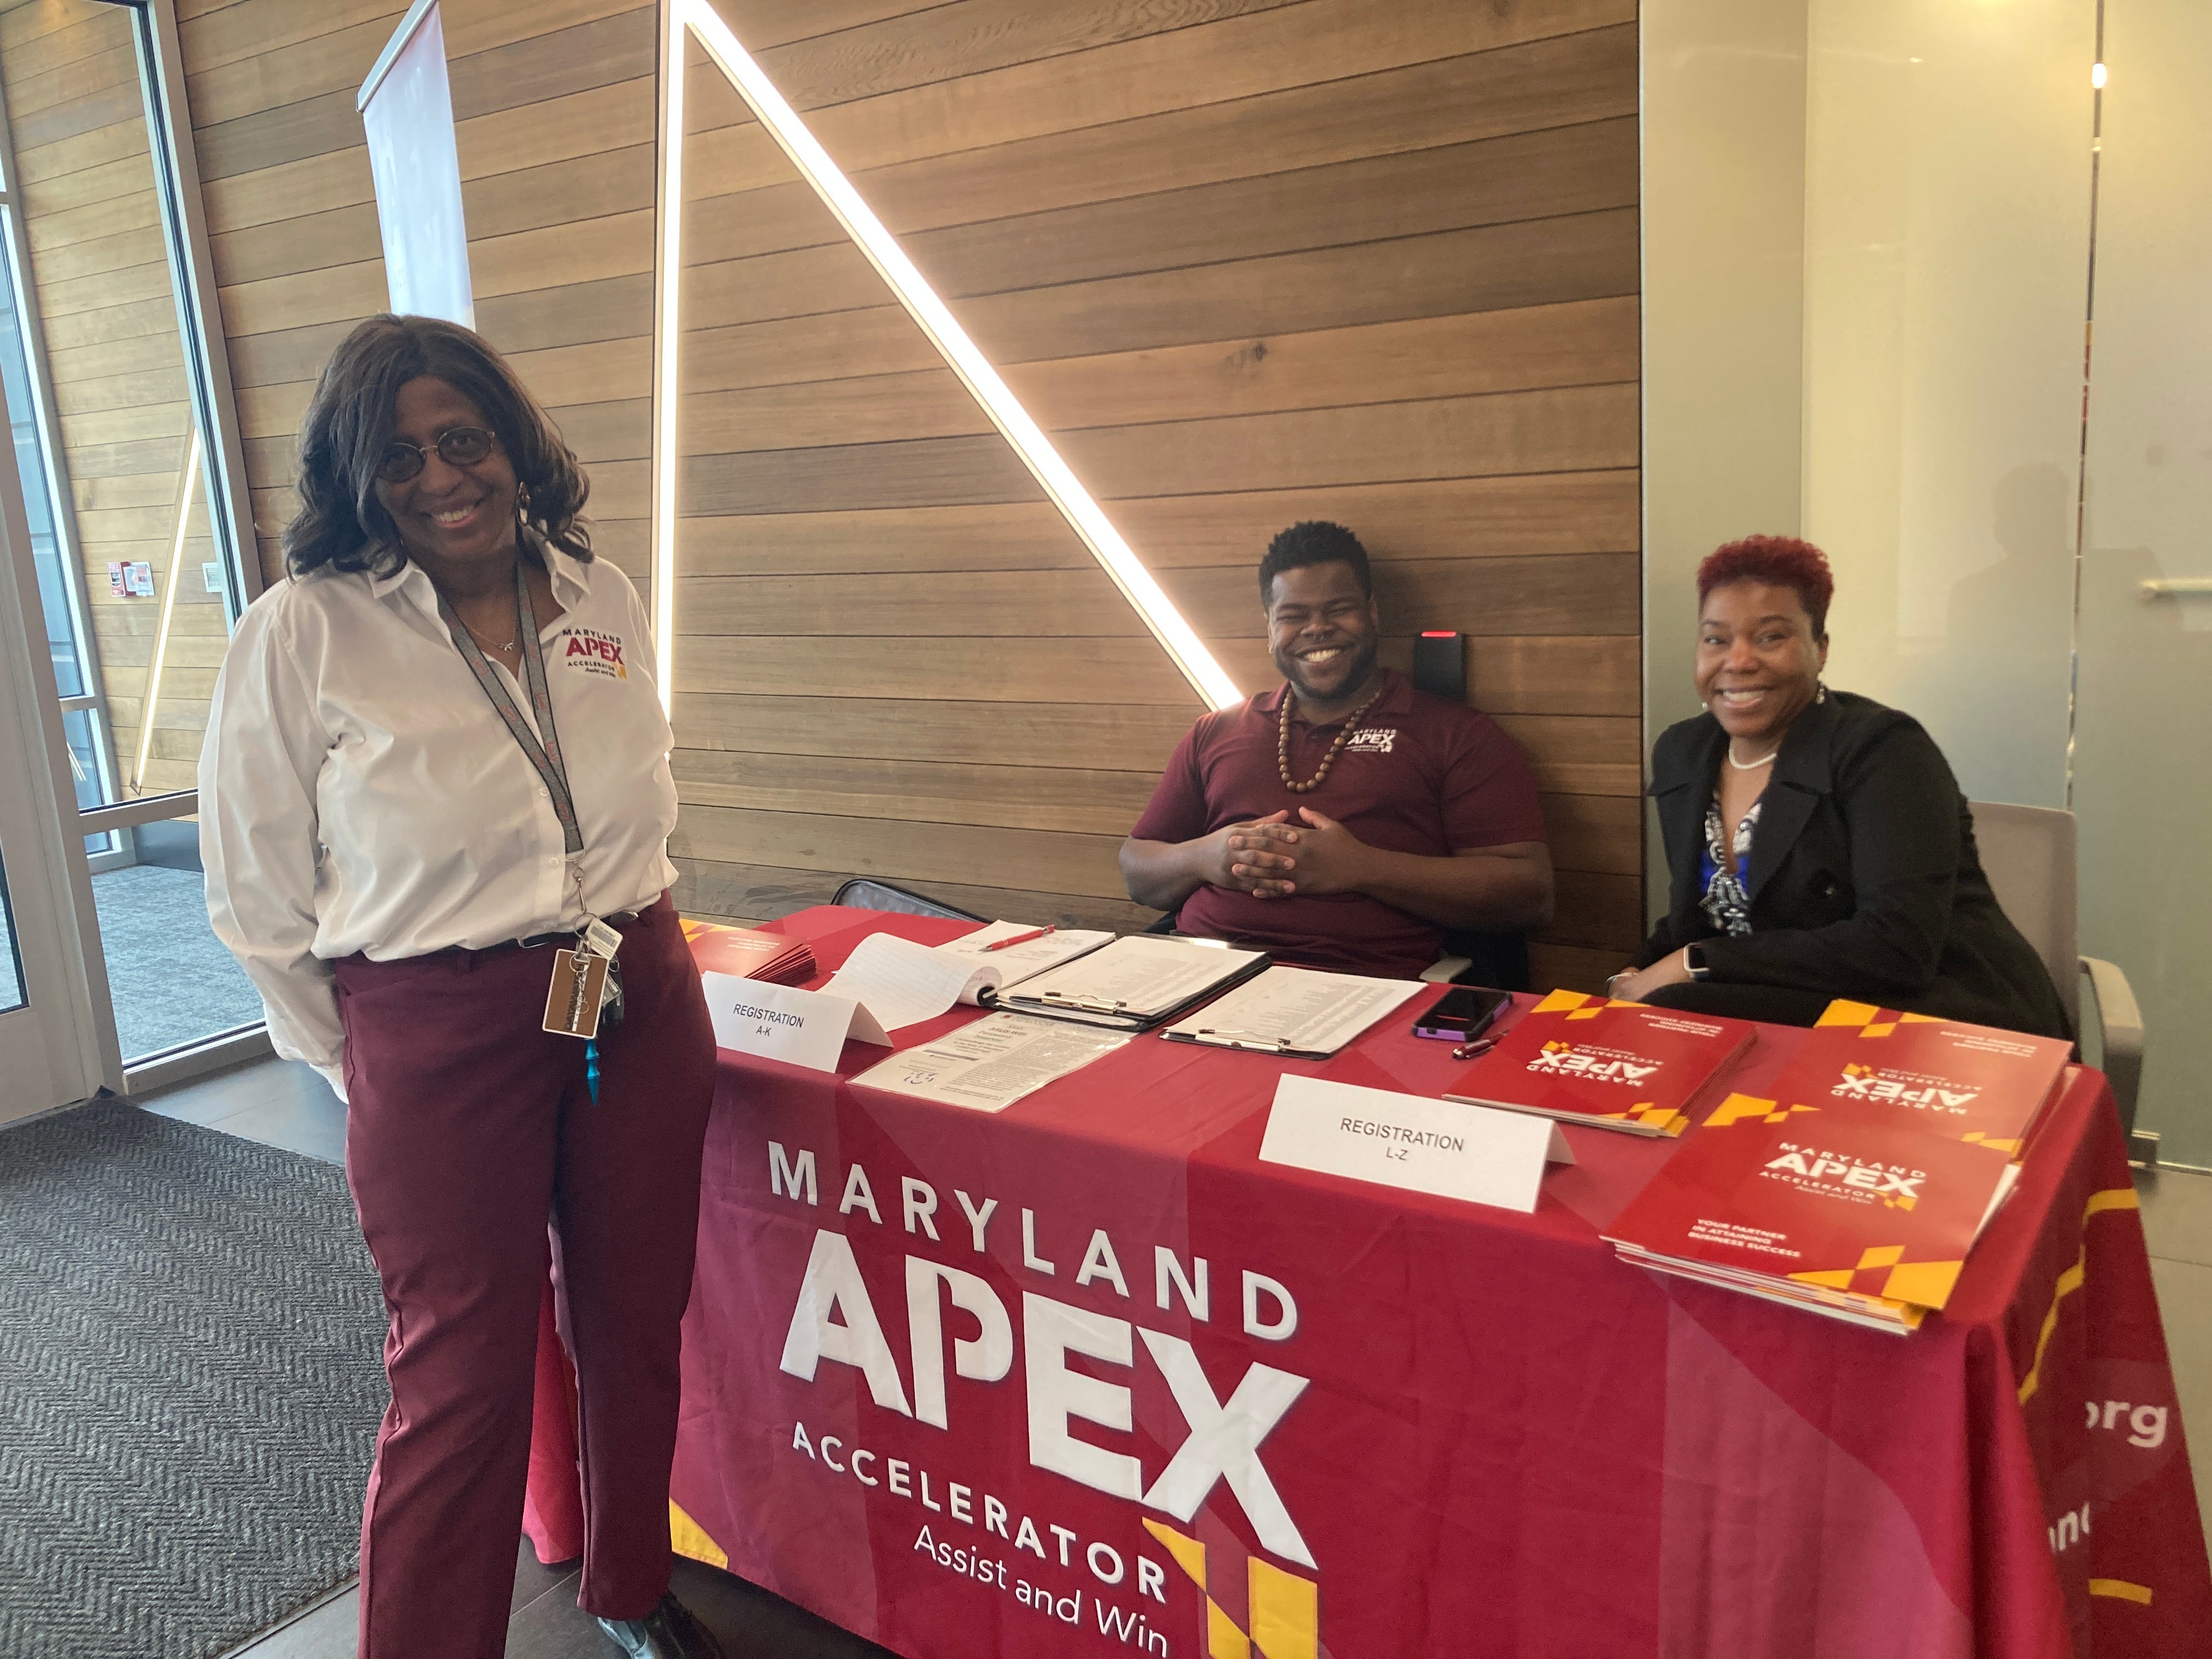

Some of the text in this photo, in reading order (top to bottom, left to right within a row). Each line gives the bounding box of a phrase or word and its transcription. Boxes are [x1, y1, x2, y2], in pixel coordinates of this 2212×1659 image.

[563, 629, 622, 645] MARYLAND
[566, 637, 624, 665] APEX
[568, 661, 615, 672] ACCELERATOR
[1347, 733, 1396, 746] APEX
[733, 1003, 804, 1028] REGISTRATION
[755, 1025, 772, 1036] A-K
[1526, 1064, 1643, 1087] MARYLAND
[1529, 1049, 1659, 1079] APEX
[1831, 1089, 1967, 1114] MARYLAND
[1832, 1073, 1979, 1107] APEX
[1340, 1118, 1464, 1152] REGISTRATION
[1386, 1147, 1408, 1161] L-Z
[1779, 1142, 1927, 1178] MARYLAND
[1758, 1171, 1875, 1199] ACCELERATOR
[1764, 1153, 1925, 1198] APEX
[768, 1141, 1298, 1340] MARYLAND
[1697, 1218, 1786, 1240] YOUR PARTNER
[1746, 1243, 1801, 1257] SUCCESS
[779, 1228, 1318, 1569] APEX
[792, 1421, 1166, 1604] ACCELERATOR
[913, 1525, 1168, 1658] Assist and Win
